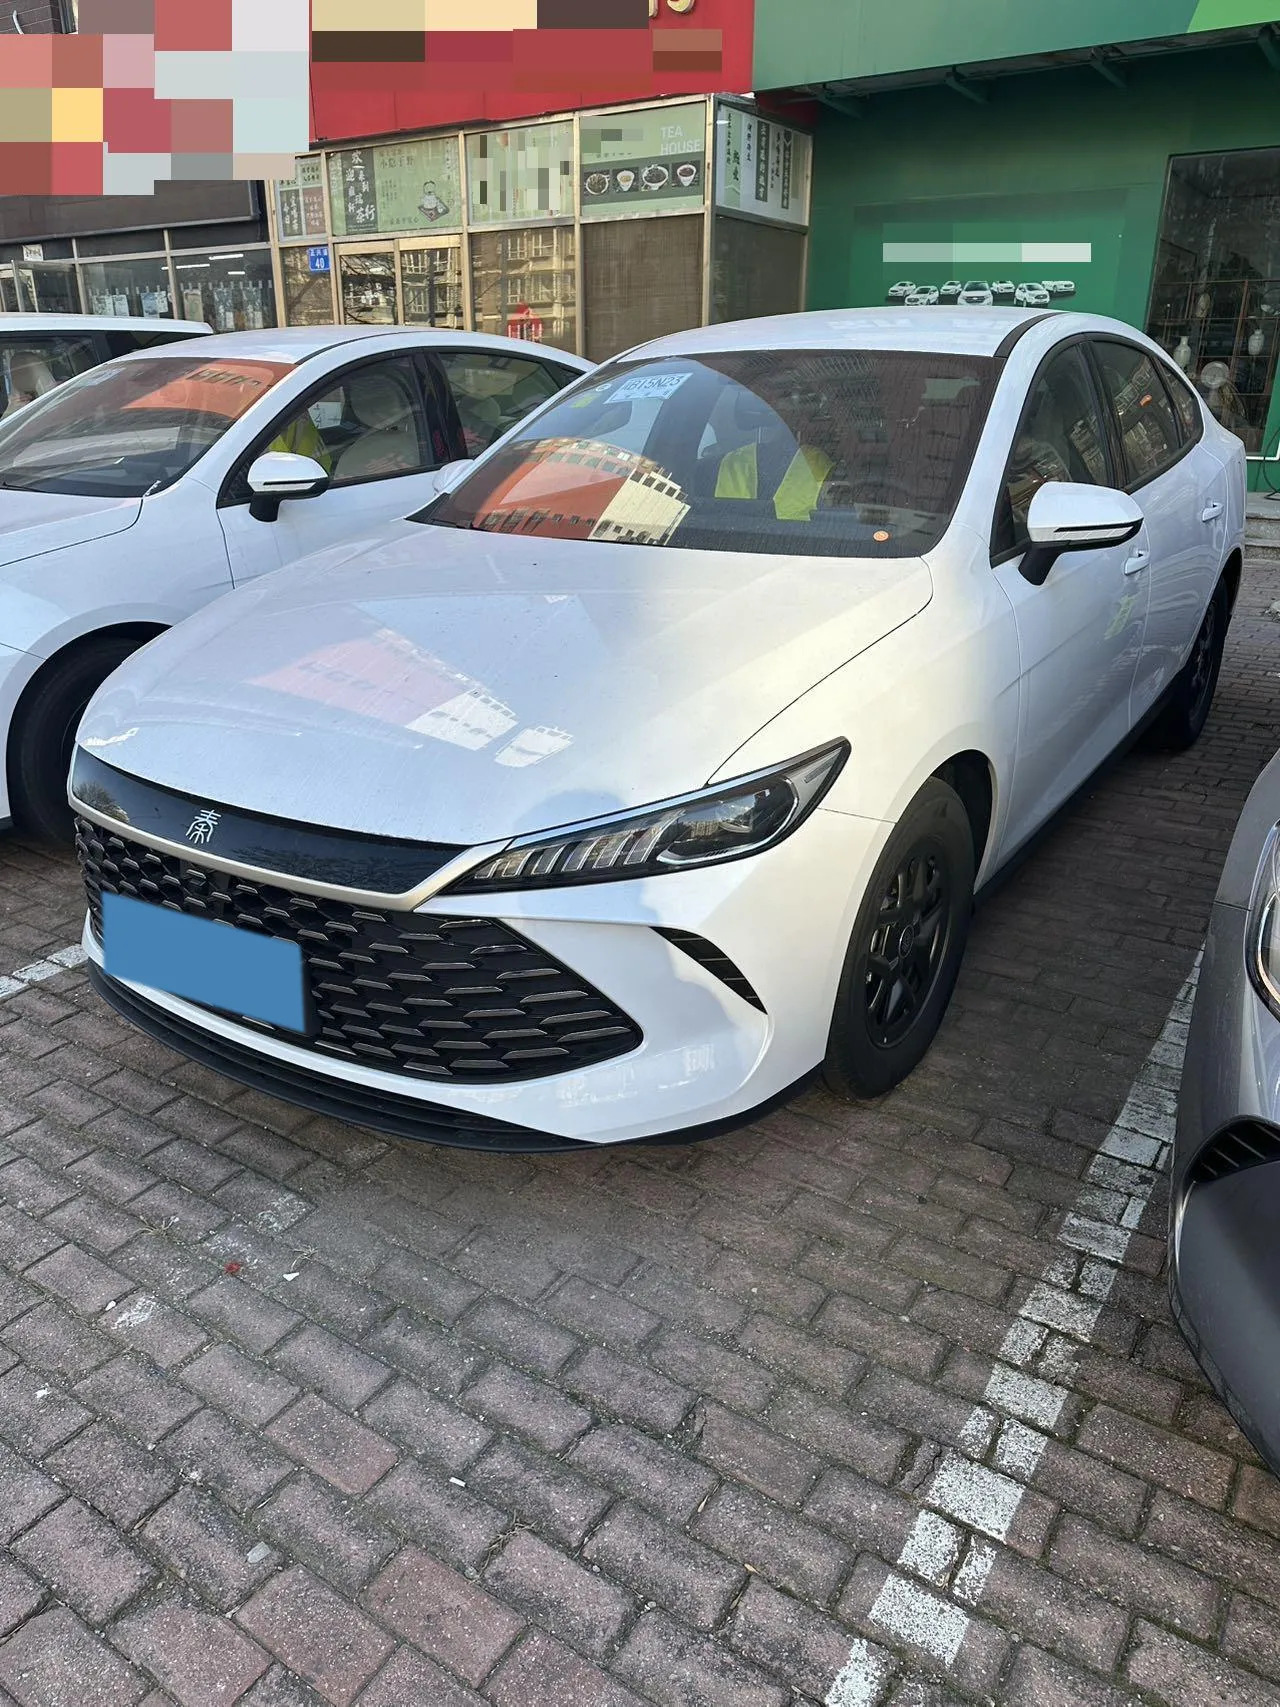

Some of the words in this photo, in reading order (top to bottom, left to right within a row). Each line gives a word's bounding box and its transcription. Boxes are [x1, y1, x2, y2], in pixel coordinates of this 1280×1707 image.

[660, 126, 684, 140] TEA
[660, 139, 701, 156] HOUSE
[315, 257, 326, 269] 40
[185, 809, 222, 845] 秦
